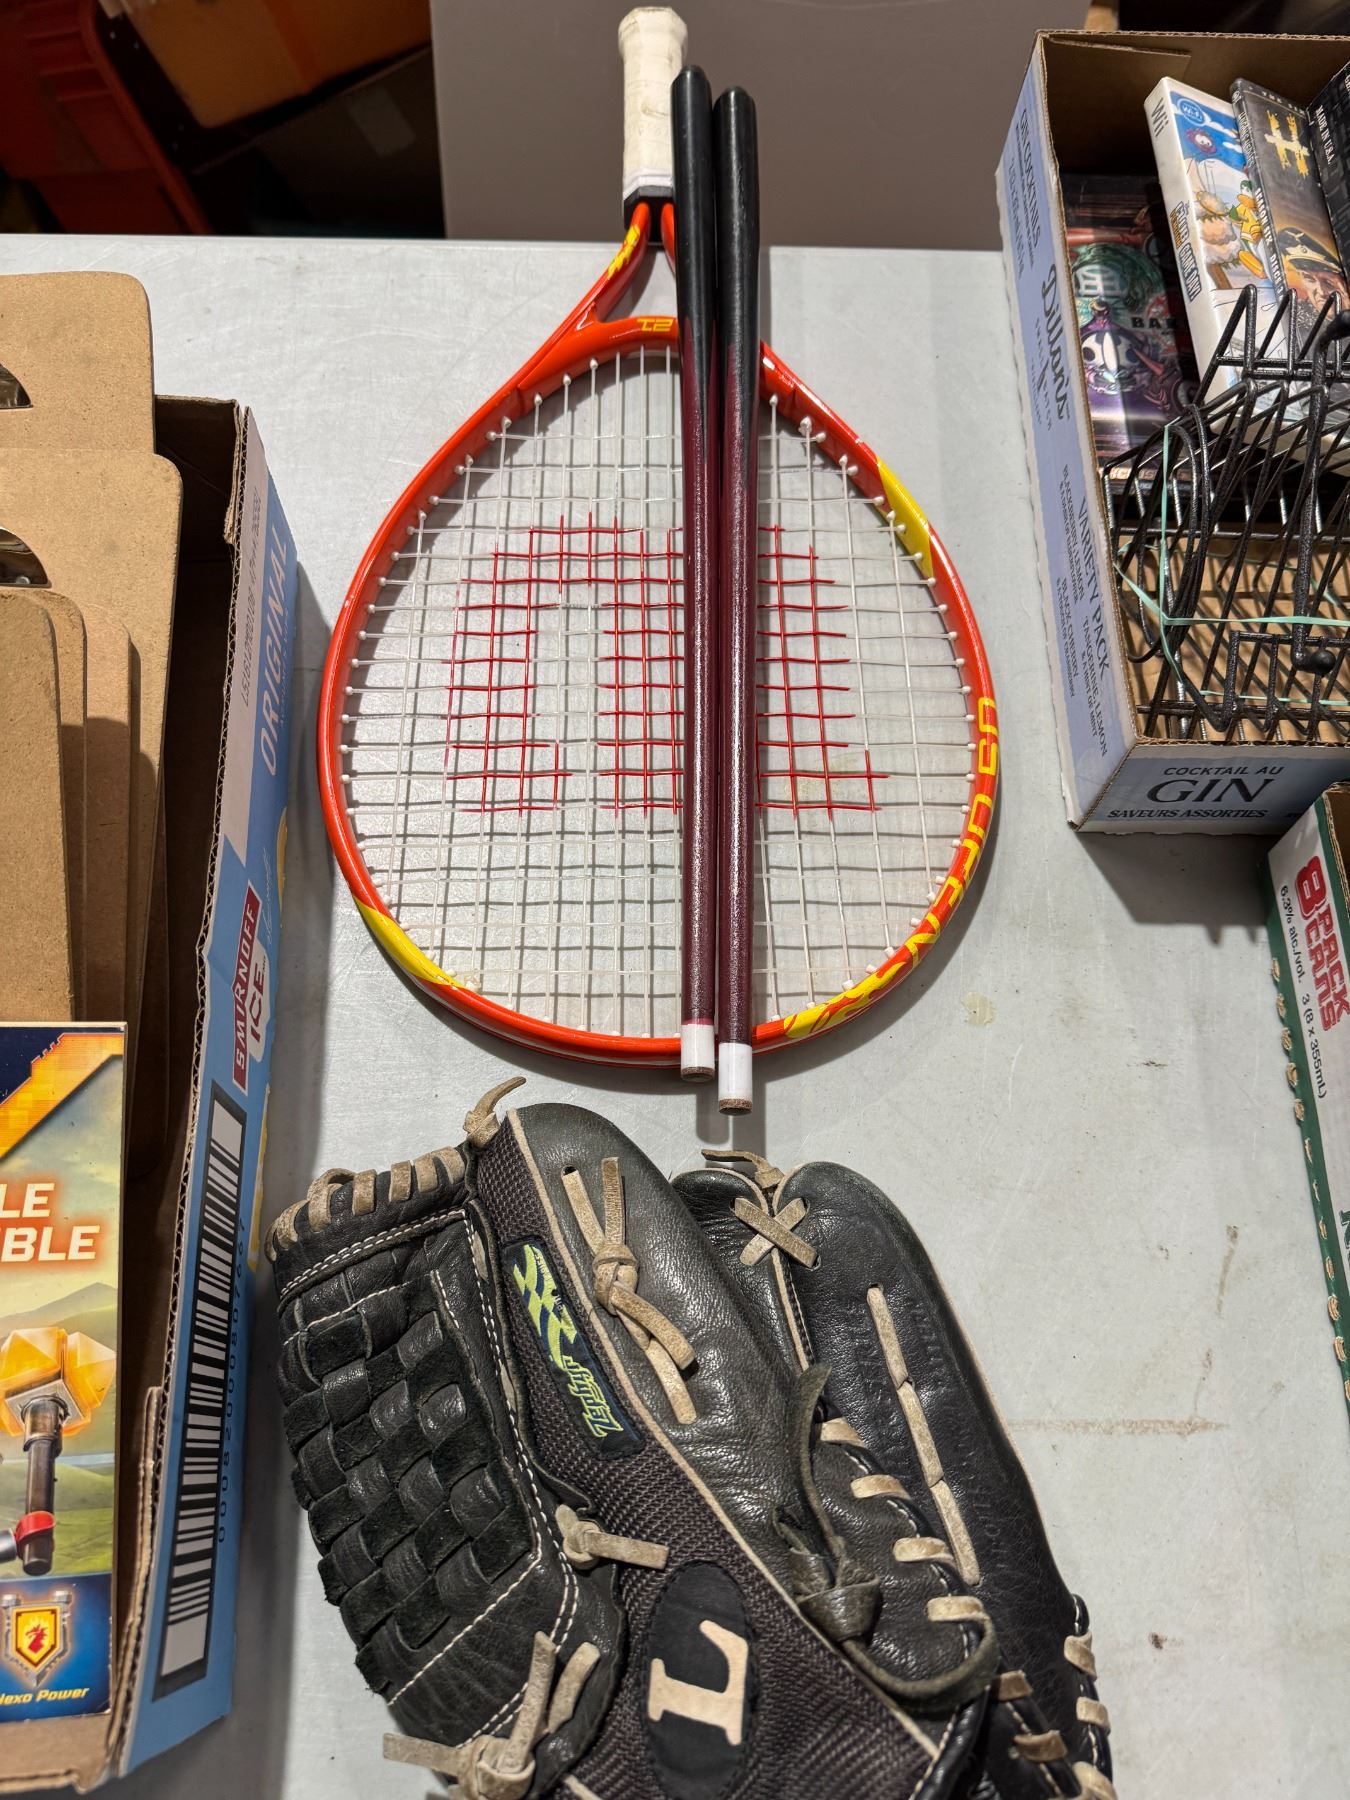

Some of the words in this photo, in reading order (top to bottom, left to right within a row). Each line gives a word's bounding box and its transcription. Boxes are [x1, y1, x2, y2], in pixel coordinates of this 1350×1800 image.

[1151, 98, 1171, 138] Wii
[1315, 105, 1326, 130] MADE
[1324, 141, 1336, 165] U.S.A.
[1023, 142, 1041, 250] COCKTAILS
[1255, 187, 1268, 224] SEASON
[1270, 253, 1283, 285] DISCS
[1042, 263, 1065, 420] Dillon's
[1063, 464, 1077, 552] BLACKBERRY,
[1075, 550, 1085, 602] LEMON
[1061, 579, 1071, 625] BLACK
[1067, 627, 1079, 679] CHERRY
[1079, 497, 1098, 608] VARIETY
[1091, 607, 1110, 680] PACK
[260, 526, 287, 777] ORIGINAL
[1084, 615, 1099, 702] TANGERINE,
[1096, 702, 1107, 758] LEMON
[978, 697, 999, 776] US
[1163, 766, 1249, 776] COCKTAIL
[1255, 766, 1284, 775] AU
[1107, 809, 1179, 818] SAVEURS
[1180, 809, 1269, 818] ASSORTIES
[1147, 778, 1275, 802] GIN
[904, 793, 993, 966] OPEN
[1280, 884, 1294, 926] 6.3%
[1294, 855, 1328, 918] 8
[234, 907, 256, 1071] SMIRNOFF
[1286, 926, 1305, 984] alc./vol.
[1304, 918, 1335, 1032] CANS
[1316, 902, 1350, 1018] PACK
[249, 961, 267, 1044] ICE
[1309, 1040, 1328, 1098] 355mL)
[562, 1353, 625, 1439] Zephyr
[36, 1686, 91, 1703] Power
